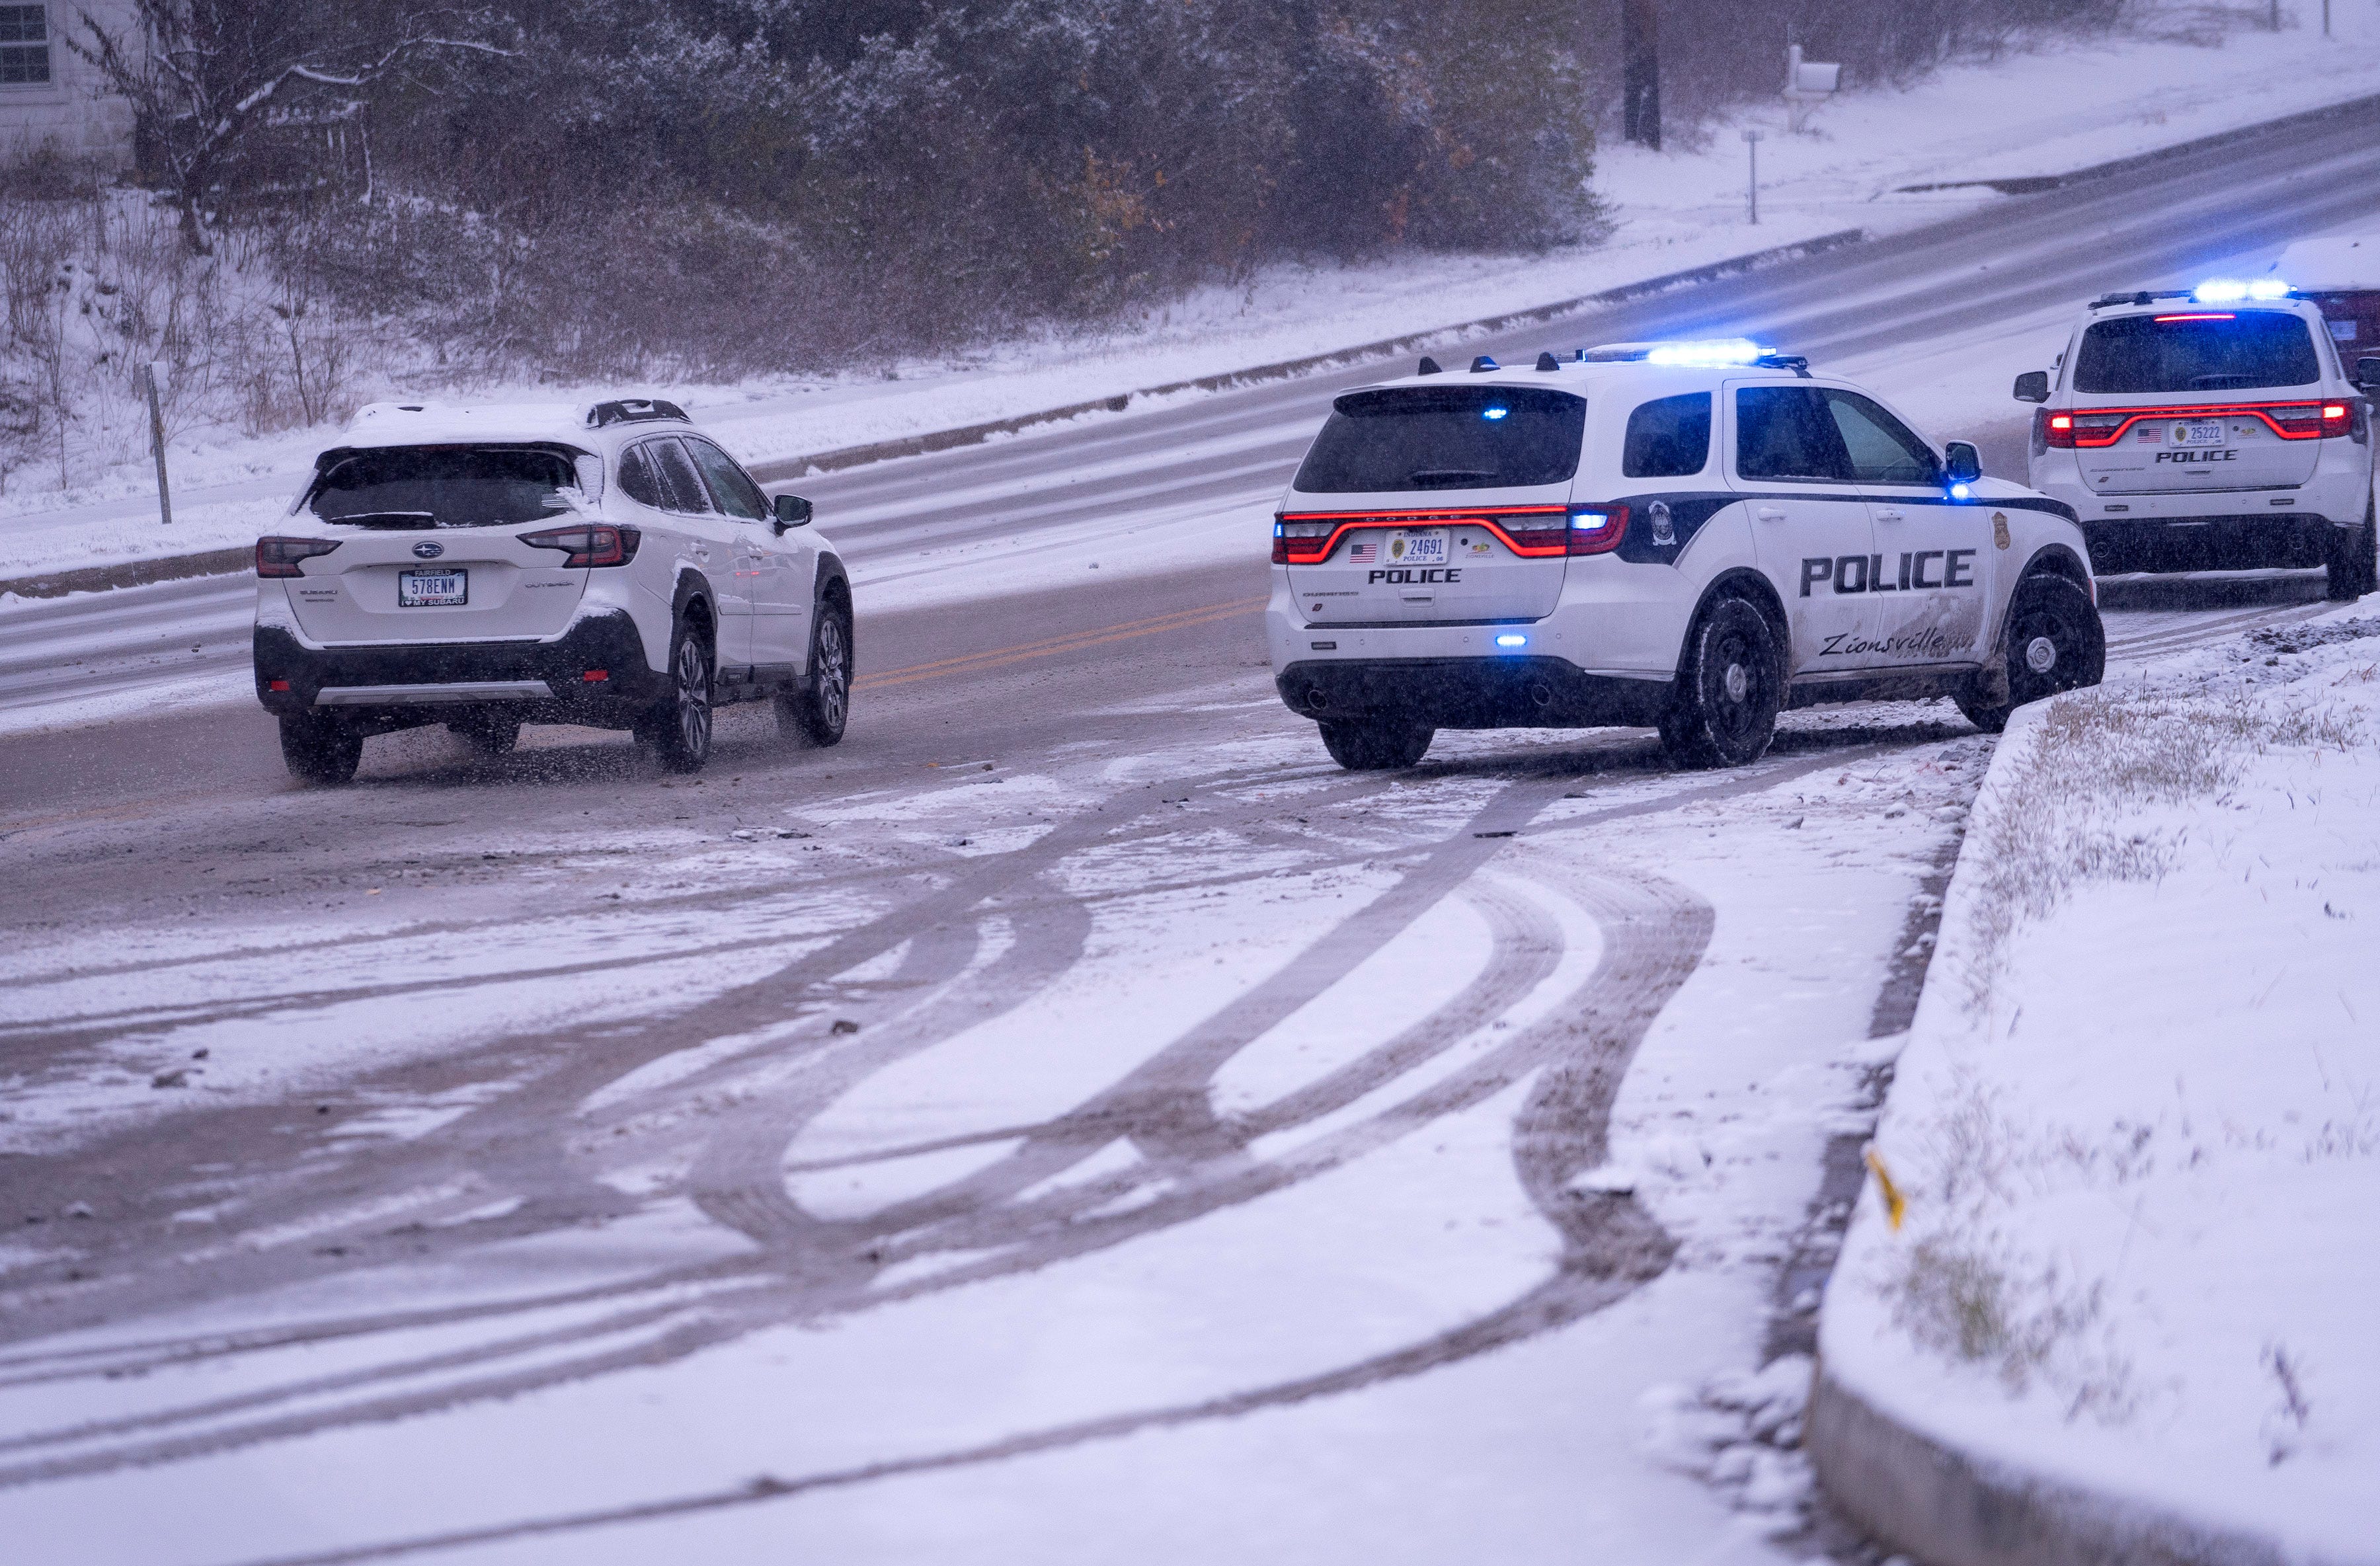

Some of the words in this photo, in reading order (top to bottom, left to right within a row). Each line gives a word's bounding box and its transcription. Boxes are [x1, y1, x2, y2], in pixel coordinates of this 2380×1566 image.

[2191, 426, 2220, 439] 25222
[2155, 450, 2239, 463] POLICE
[1410, 539, 1443, 555] 24691
[1368, 568, 1462, 584] POLICE
[1800, 548, 1977, 598] POLICE
[412, 578, 455, 594] 578ENM
[428, 596, 464, 606] SUBARU
[1819, 627, 1944, 656] Zionsville
